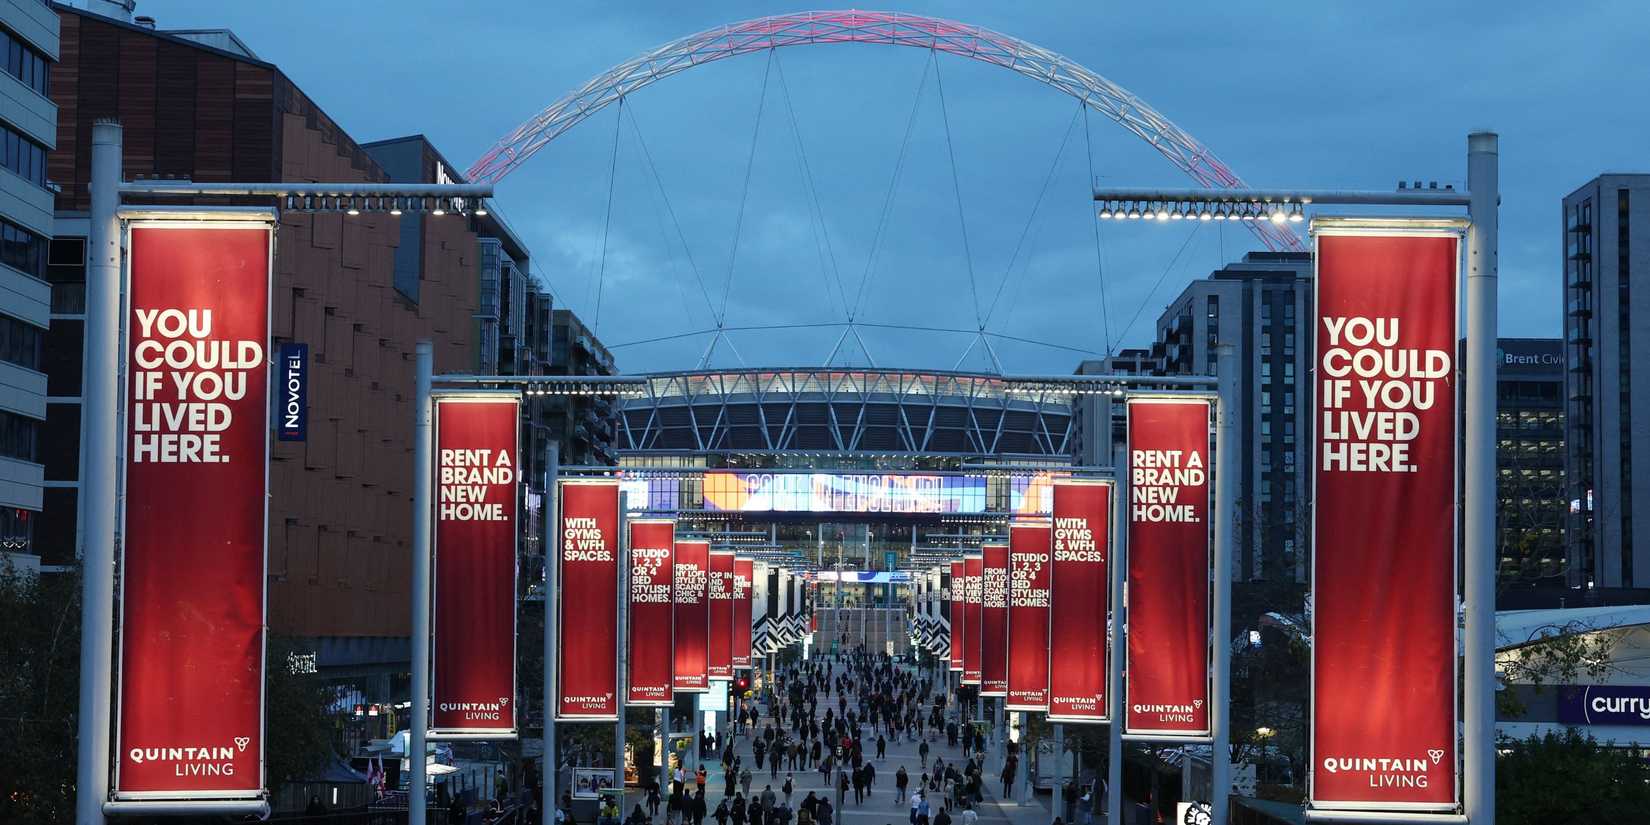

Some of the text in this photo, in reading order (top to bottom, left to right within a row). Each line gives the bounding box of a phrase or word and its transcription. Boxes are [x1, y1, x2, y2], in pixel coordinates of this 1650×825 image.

[136, 309, 212, 338] YOU
[1323, 317, 1398, 346] YOU
[135, 340, 262, 369] COULD
[1505, 353, 1538, 364] Brent
[1323, 348, 1450, 380] COULD
[136, 371, 246, 400] IF YOU
[285, 349, 301, 428] NOVOTEL
[1324, 380, 1434, 410] IF YOU
[135, 403, 232, 431] LIVED
[1324, 411, 1419, 440] LIVED
[134, 434, 229, 462] HERE.
[442, 449, 511, 466] RENT A
[1133, 450, 1203, 468] RENT A
[1323, 443, 1417, 472] HERE.
[442, 467, 512, 484] BRAND
[1133, 469, 1204, 486] BRAND
[441, 485, 487, 502] NEW
[1133, 487, 1178, 503] NEW
[441, 504, 507, 520] HOME.
[1133, 505, 1199, 522] HOME.
[565, 518, 596, 529] WITH
[1055, 518, 1087, 529] WITH
[564, 529, 602, 540] GYMS
[1055, 528, 1092, 540] GYMS
[564, 539, 605, 551] & WFH
[1055, 539, 1096, 551] & WFH
[564, 550, 614, 562] SPACES.
[632, 549, 669, 558] STUDIO
[1011, 553, 1048, 563] STUDIO
[1055, 551, 1104, 562] SPACES.
[632, 559, 662, 568] 1, 2, 3
[1012, 562, 1041, 572] 1, 2, 3
[632, 567, 657, 576] OR 4
[1012, 571, 1036, 580] OR 4
[632, 576, 651, 584] BED
[1012, 580, 1030, 589] BED
[632, 585, 670, 593] STYLISH
[984, 587, 1008, 595] SCAN
[1011, 589, 1049, 598] STYLISH
[632, 594, 671, 603] HOMES.
[966, 596, 982, 604] TOD
[1011, 598, 1050, 608] HOMES.
[440, 702, 500, 712] QUINTAIN
[1053, 697, 1097, 705] QUINTAIN
[1133, 704, 1193, 714] QUINTAIN
[465, 712, 500, 720] LIVING
[1159, 714, 1194, 722] LIVING
[130, 748, 234, 761] QUINTAIN
[176, 763, 233, 776] LIVING
[1324, 758, 1428, 773] QUINTAIN
[1370, 775, 1427, 787] LIVING
